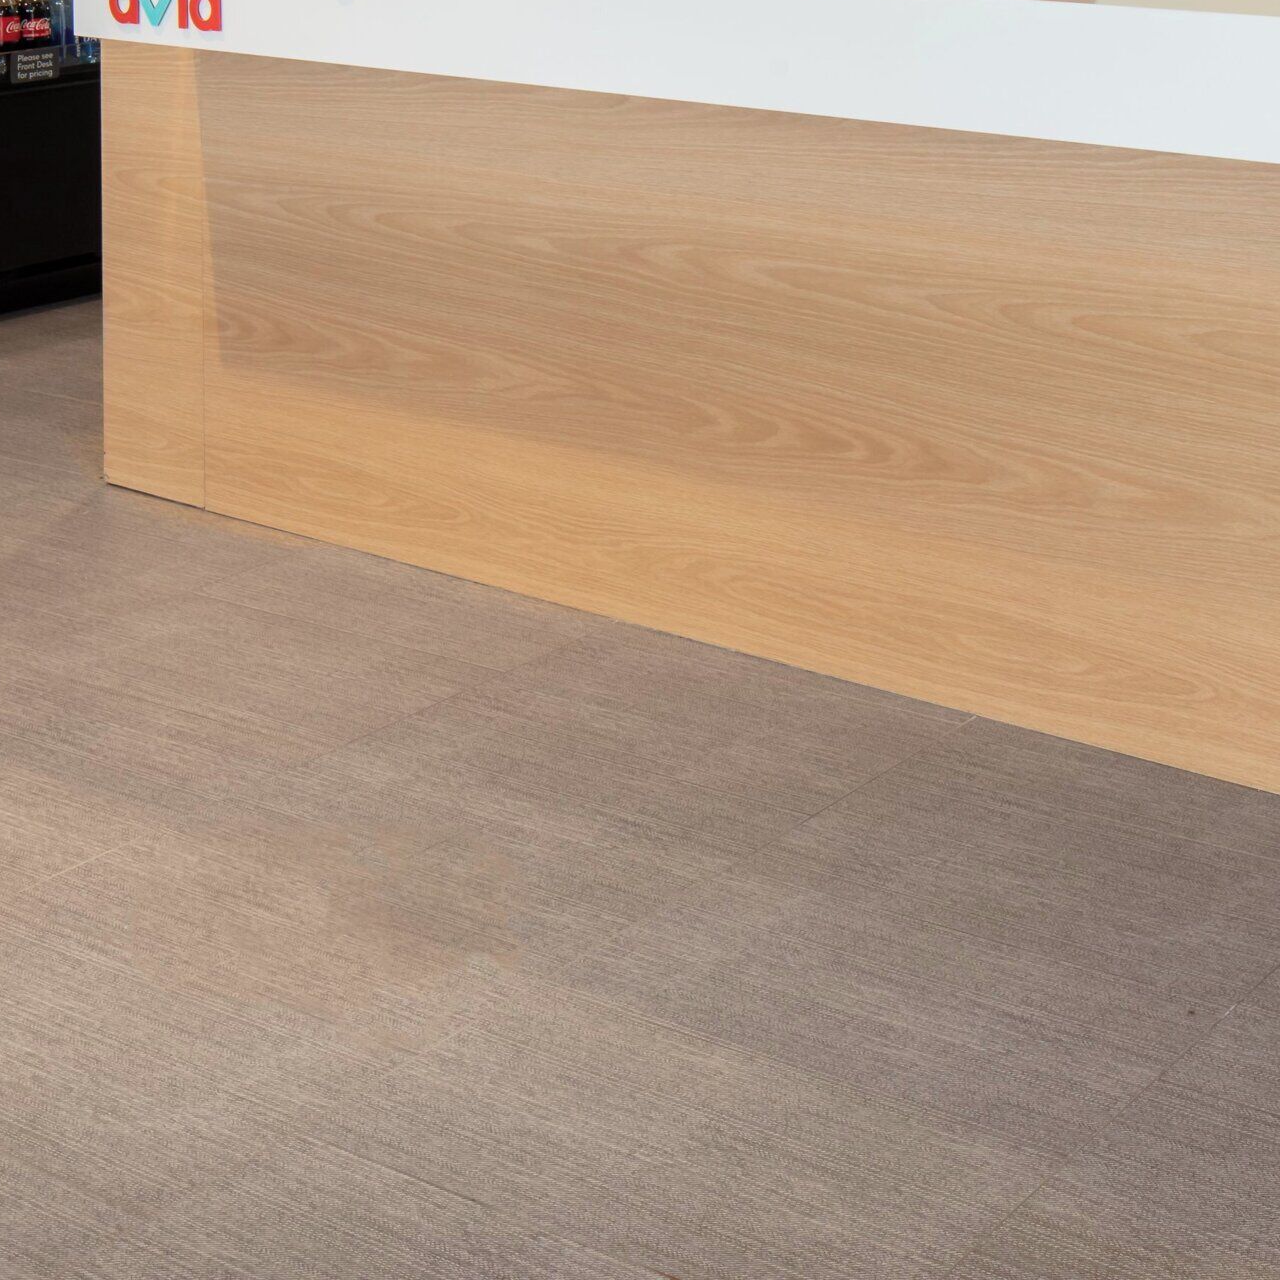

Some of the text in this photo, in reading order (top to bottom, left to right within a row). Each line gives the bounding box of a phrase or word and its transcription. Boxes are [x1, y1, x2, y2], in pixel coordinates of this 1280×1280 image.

[17, 54, 40, 62] Please
[17, 60, 53, 71] Front Desk
[17, 69, 53, 80] for pricing
